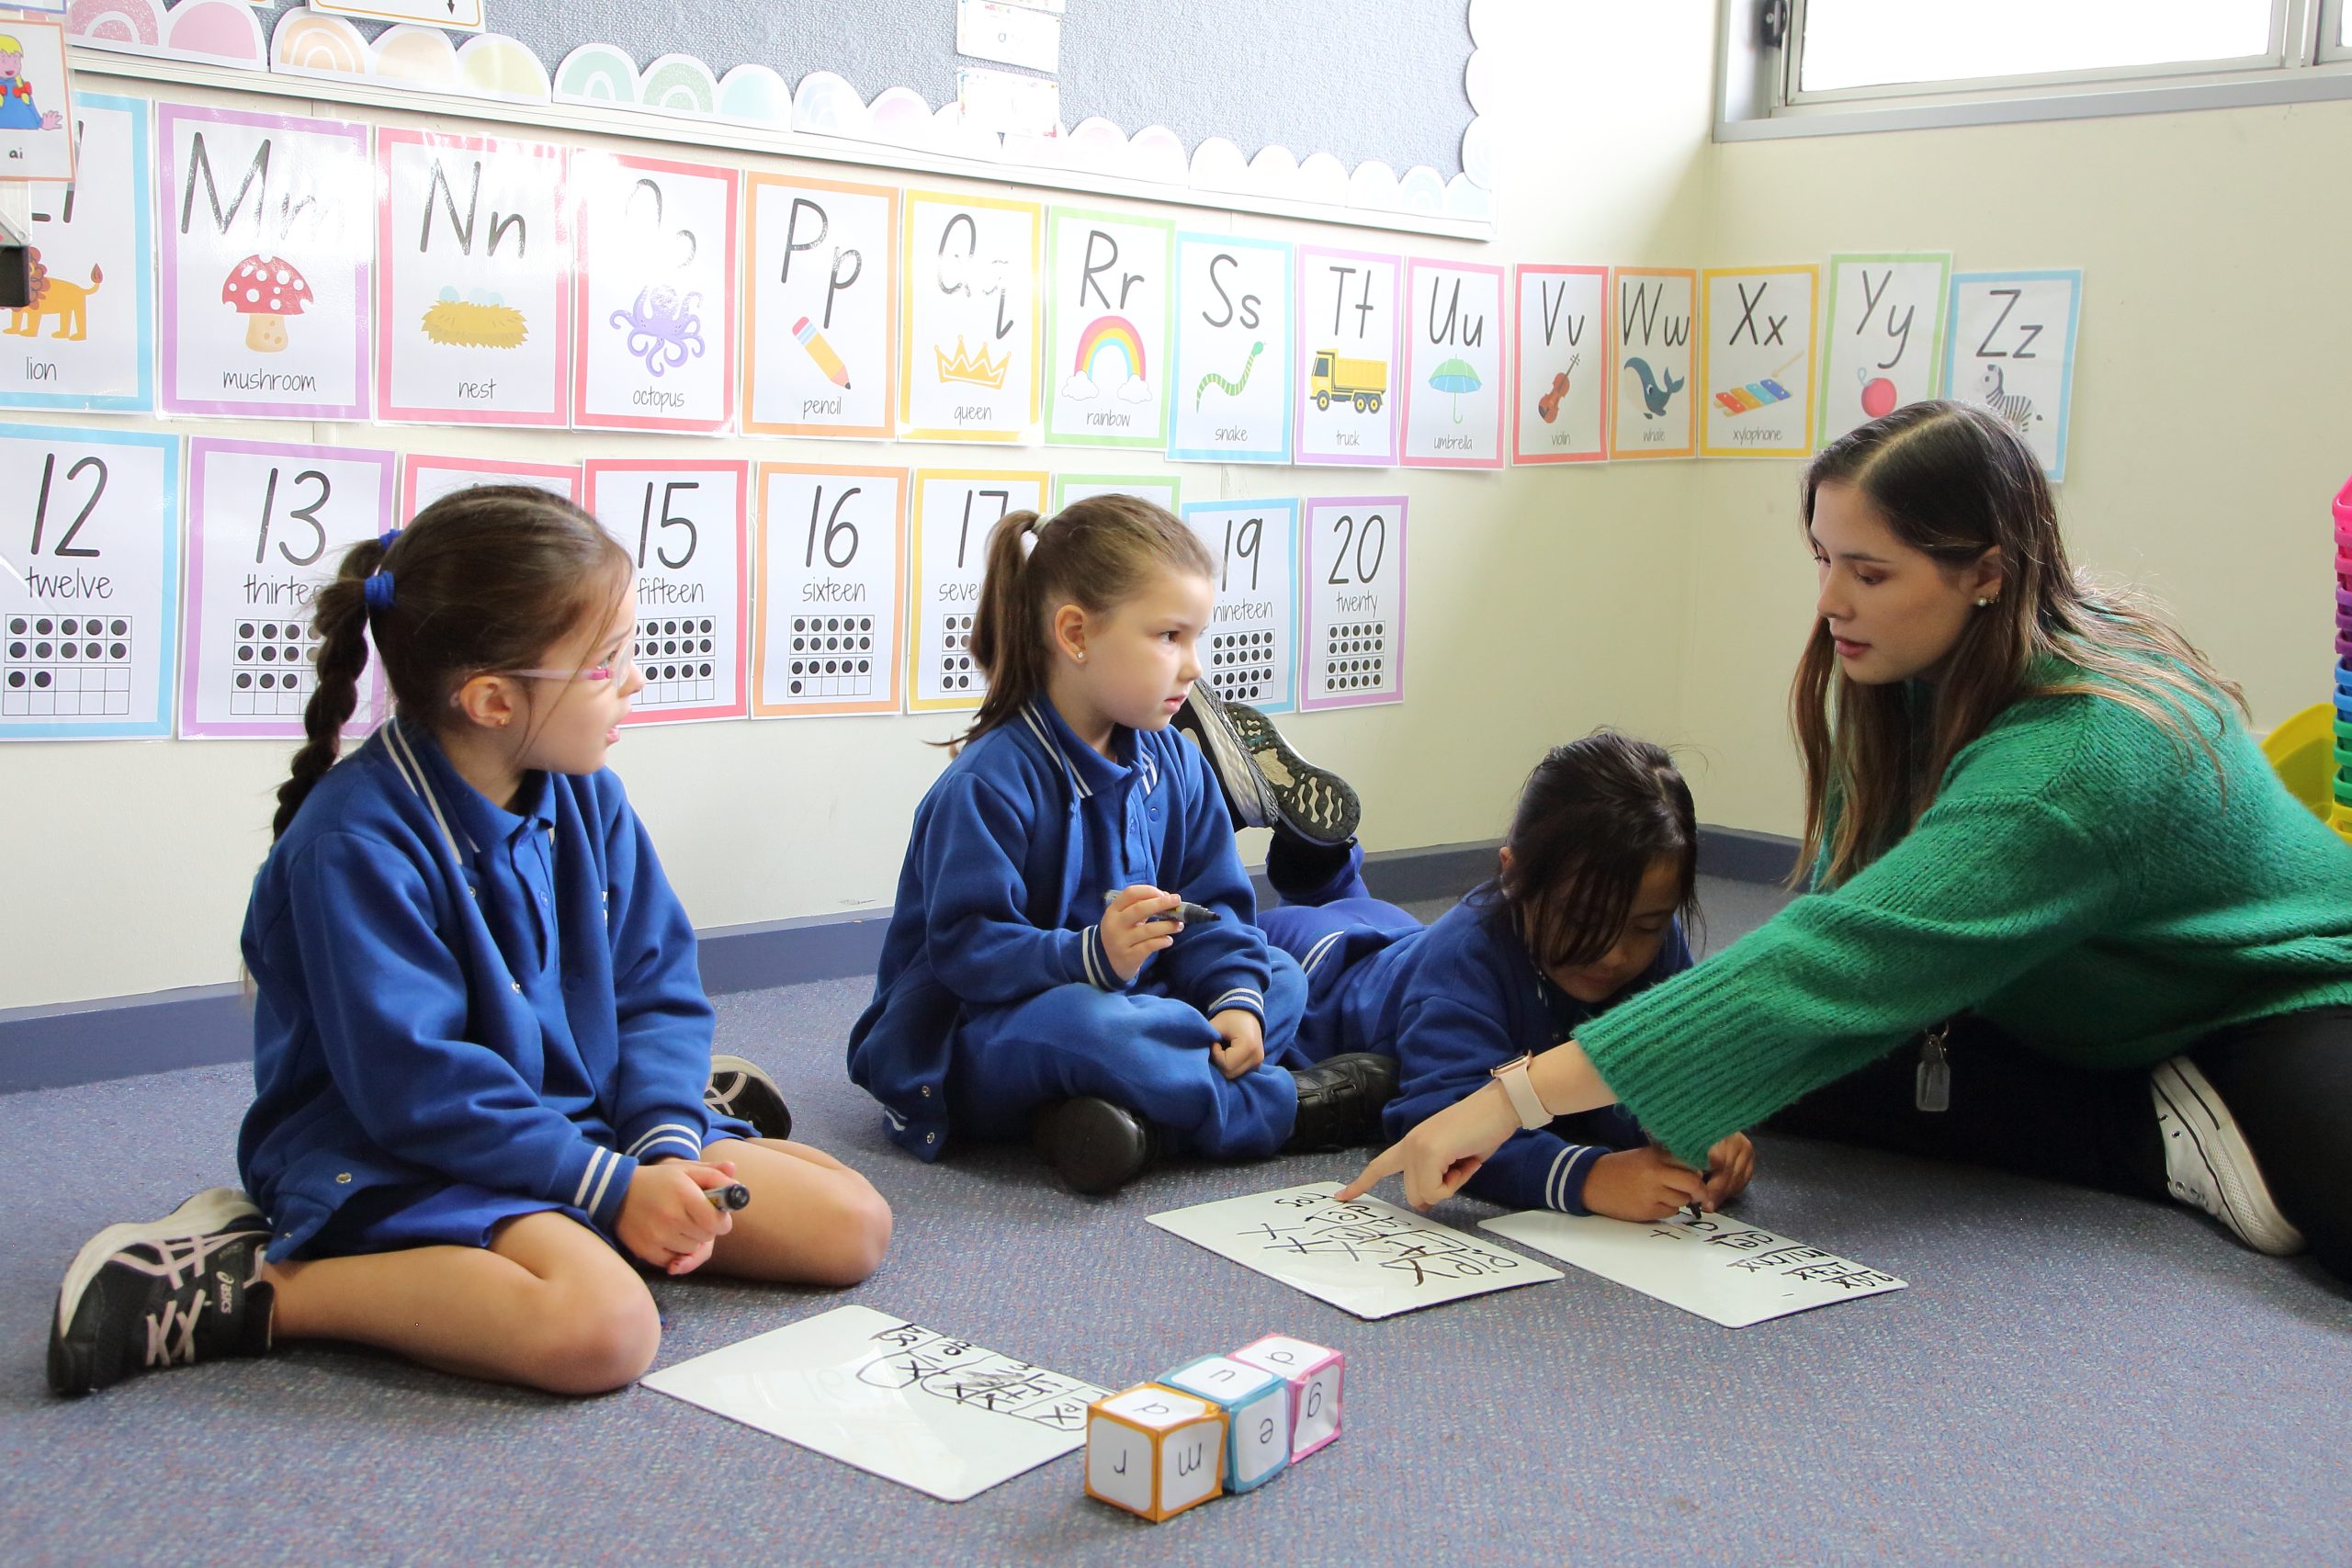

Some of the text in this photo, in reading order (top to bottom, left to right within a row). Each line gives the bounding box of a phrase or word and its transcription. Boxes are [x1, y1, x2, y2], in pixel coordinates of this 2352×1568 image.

[9, 148, 22, 159] ai
[420, 159, 526, 258] Nn
[781, 198, 862, 329] Pp
[1080, 231, 1144, 310] Rr
[1203, 254, 1261, 329] Ss
[1329, 266, 1374, 338] Tt
[1430, 276, 1483, 347] Uu
[1543, 281, 1585, 346] Vv
[1623, 282, 1690, 346] Ww
[1729, 282, 1787, 345] Xx
[1857, 271, 1914, 369] Yy
[1976, 289, 2043, 358] Zz
[27, 356, 56, 380] lion
[223, 368, 316, 391] mushroom
[458, 375, 497, 400] nest
[633, 386, 684, 408] octopus
[802, 396, 842, 420] pencil
[954, 405, 992, 422] queen
[1086, 410, 1131, 428] rainbow
[1215, 424, 1248, 443] snake
[1336, 431, 1360, 447] truck
[1433, 434, 1473, 451] umbrella
[1551, 432, 1570, 446] violin
[1643, 429, 1666, 443] whale
[1734, 428, 1782, 446] xylophone
[30, 453, 107, 557] 12
[256, 468, 331, 566] 13
[638, 481, 699, 570] 15
[806, 485, 861, 568] 16
[1222, 518, 1262, 592] 19
[1329, 514, 1385, 584] 20
[27, 566, 113, 599] twelve
[637, 577, 704, 604] fifteen
[803, 577, 865, 602] sixteen
[1214, 599, 1272, 622] nineteen
[1336, 591, 1378, 616] twenty
